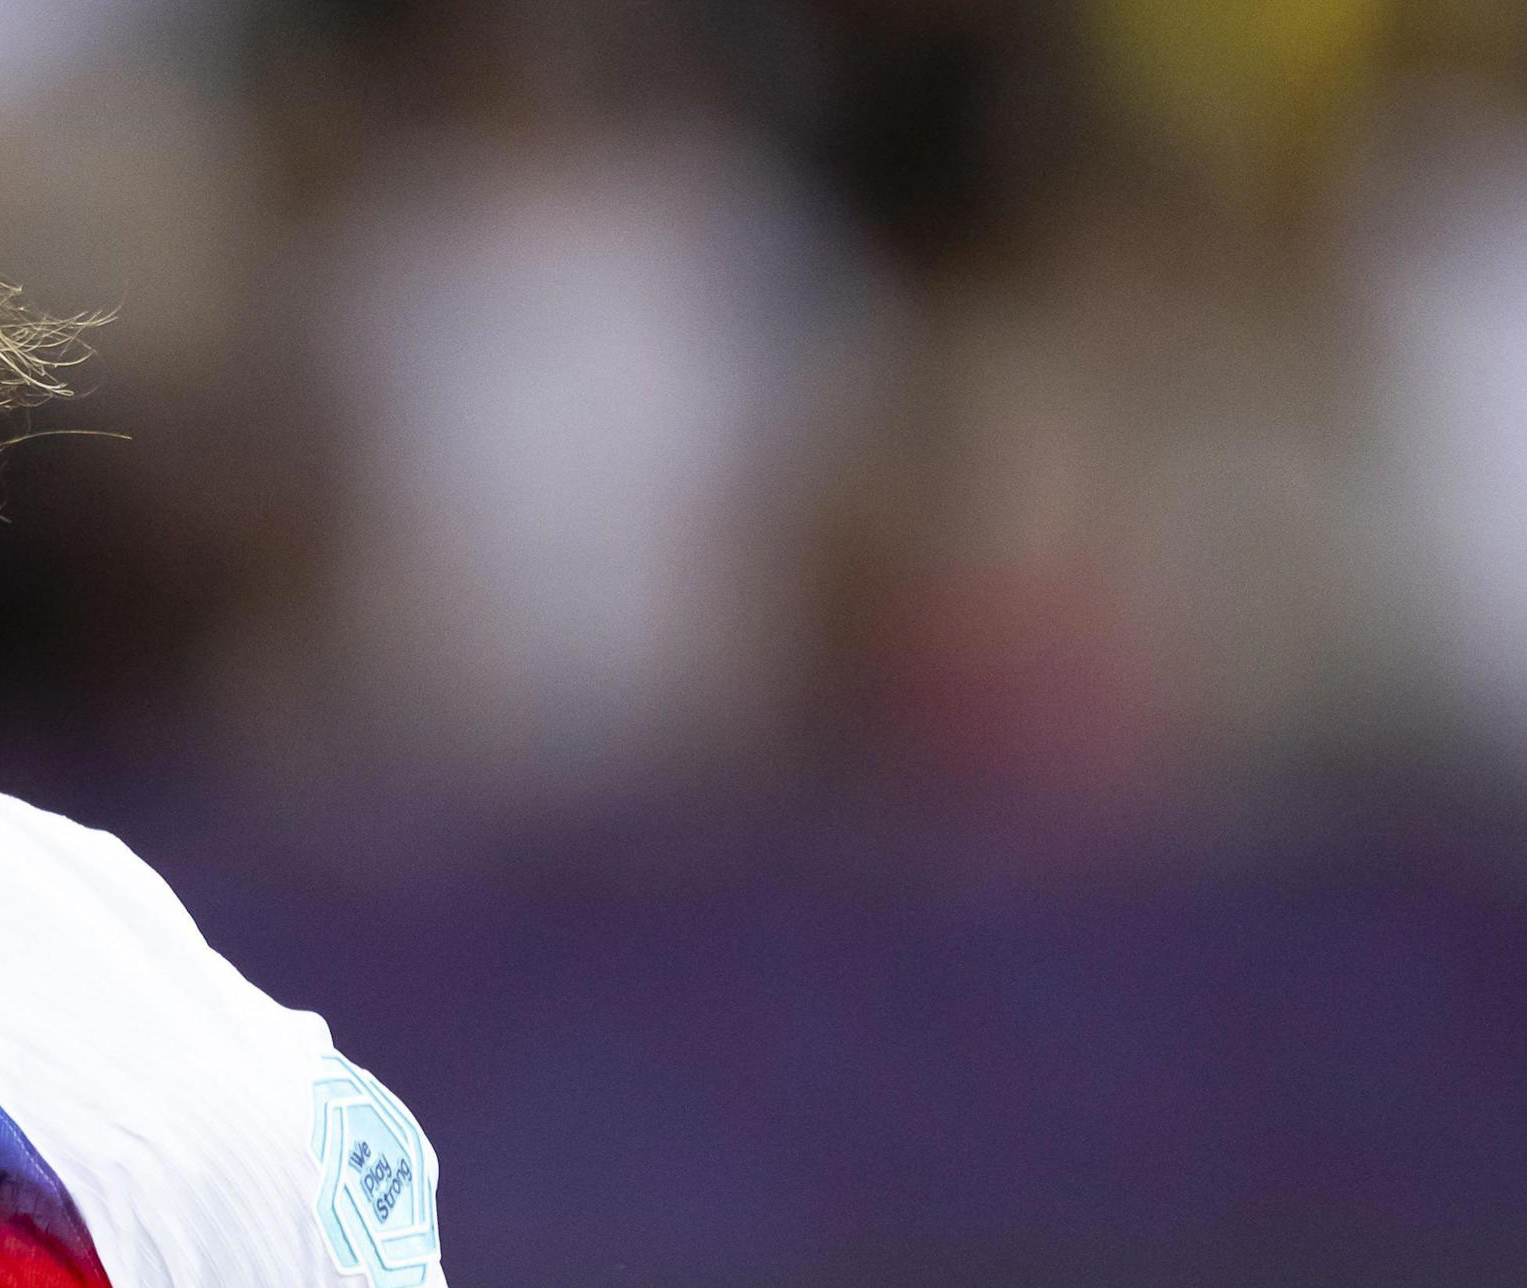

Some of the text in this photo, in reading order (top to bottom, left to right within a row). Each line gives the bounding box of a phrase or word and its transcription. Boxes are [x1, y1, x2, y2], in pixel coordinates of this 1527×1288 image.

[349, 1141, 372, 1168] We
[364, 1152, 392, 1198] Play
[376, 1158, 413, 1220] Strong
